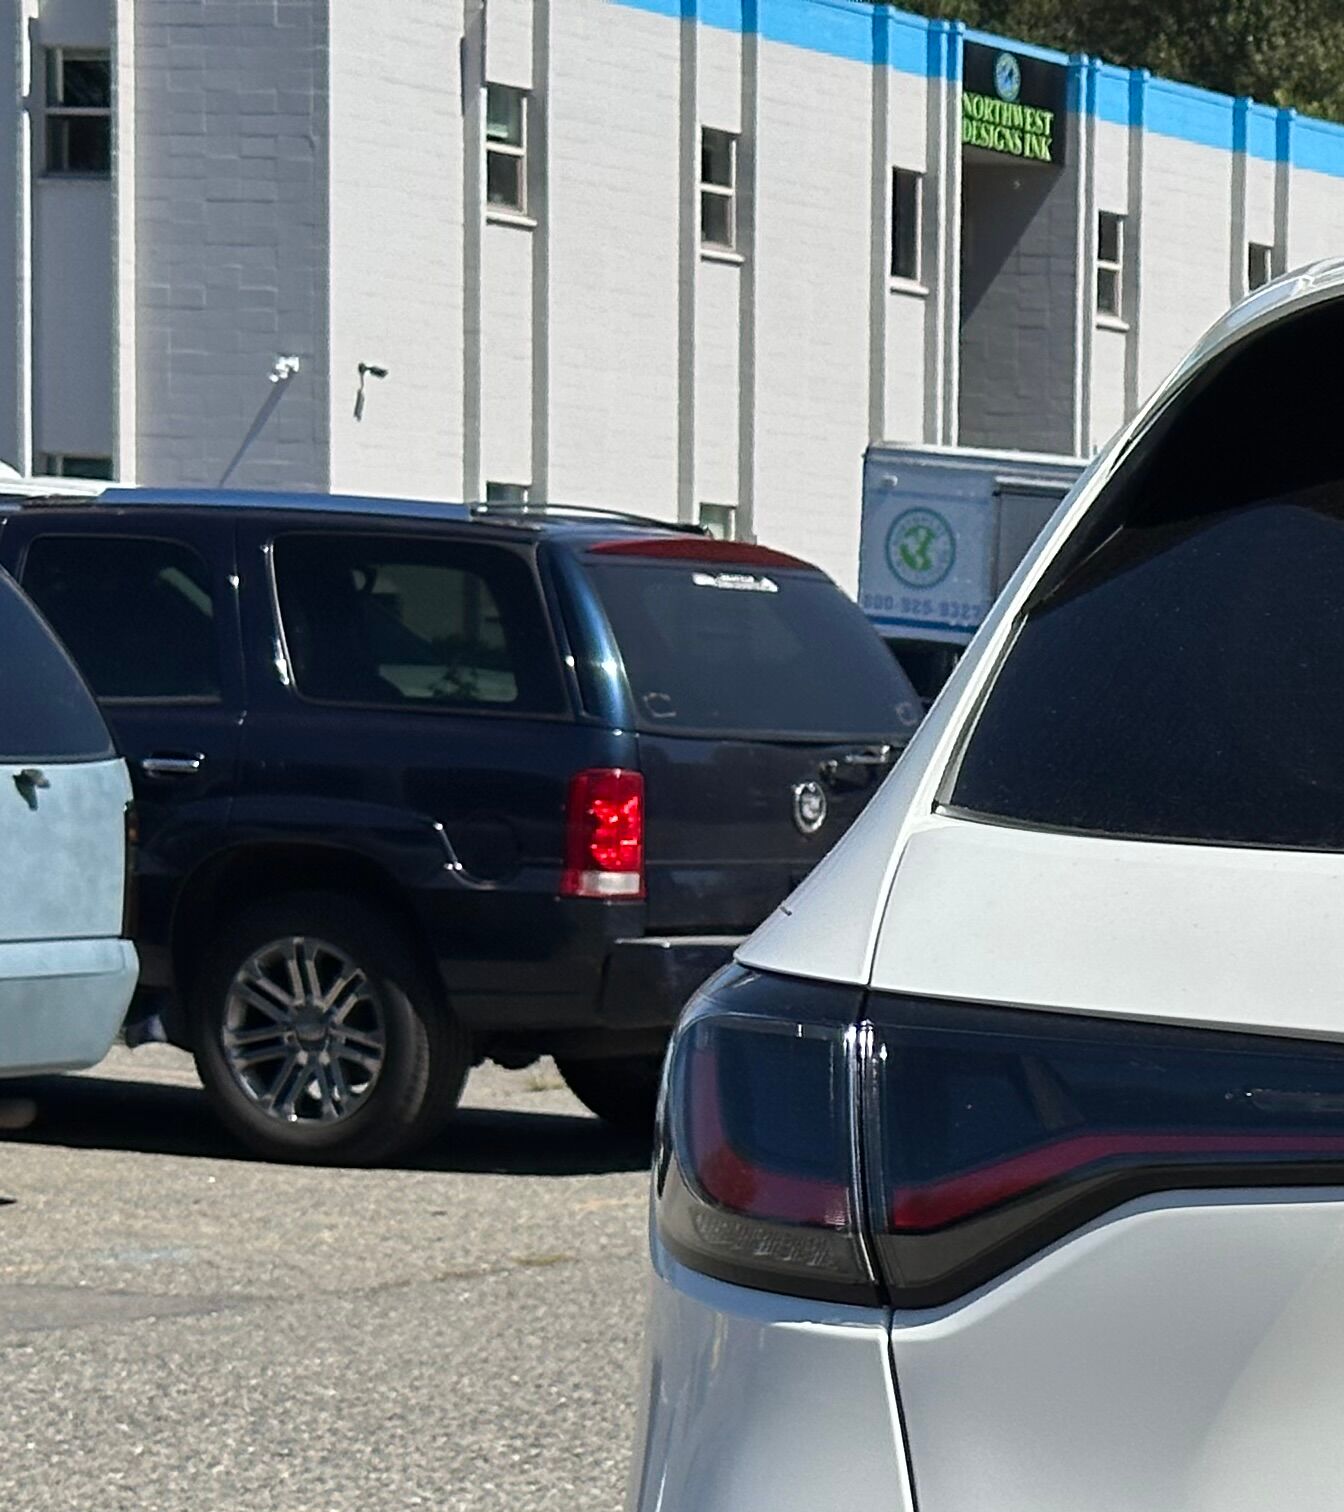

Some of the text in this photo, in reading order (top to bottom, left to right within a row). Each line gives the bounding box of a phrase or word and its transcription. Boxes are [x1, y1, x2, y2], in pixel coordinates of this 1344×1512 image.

[963, 92, 1053, 135] NORTHWEST
[963, 118, 1053, 162] DESIGNS INK
